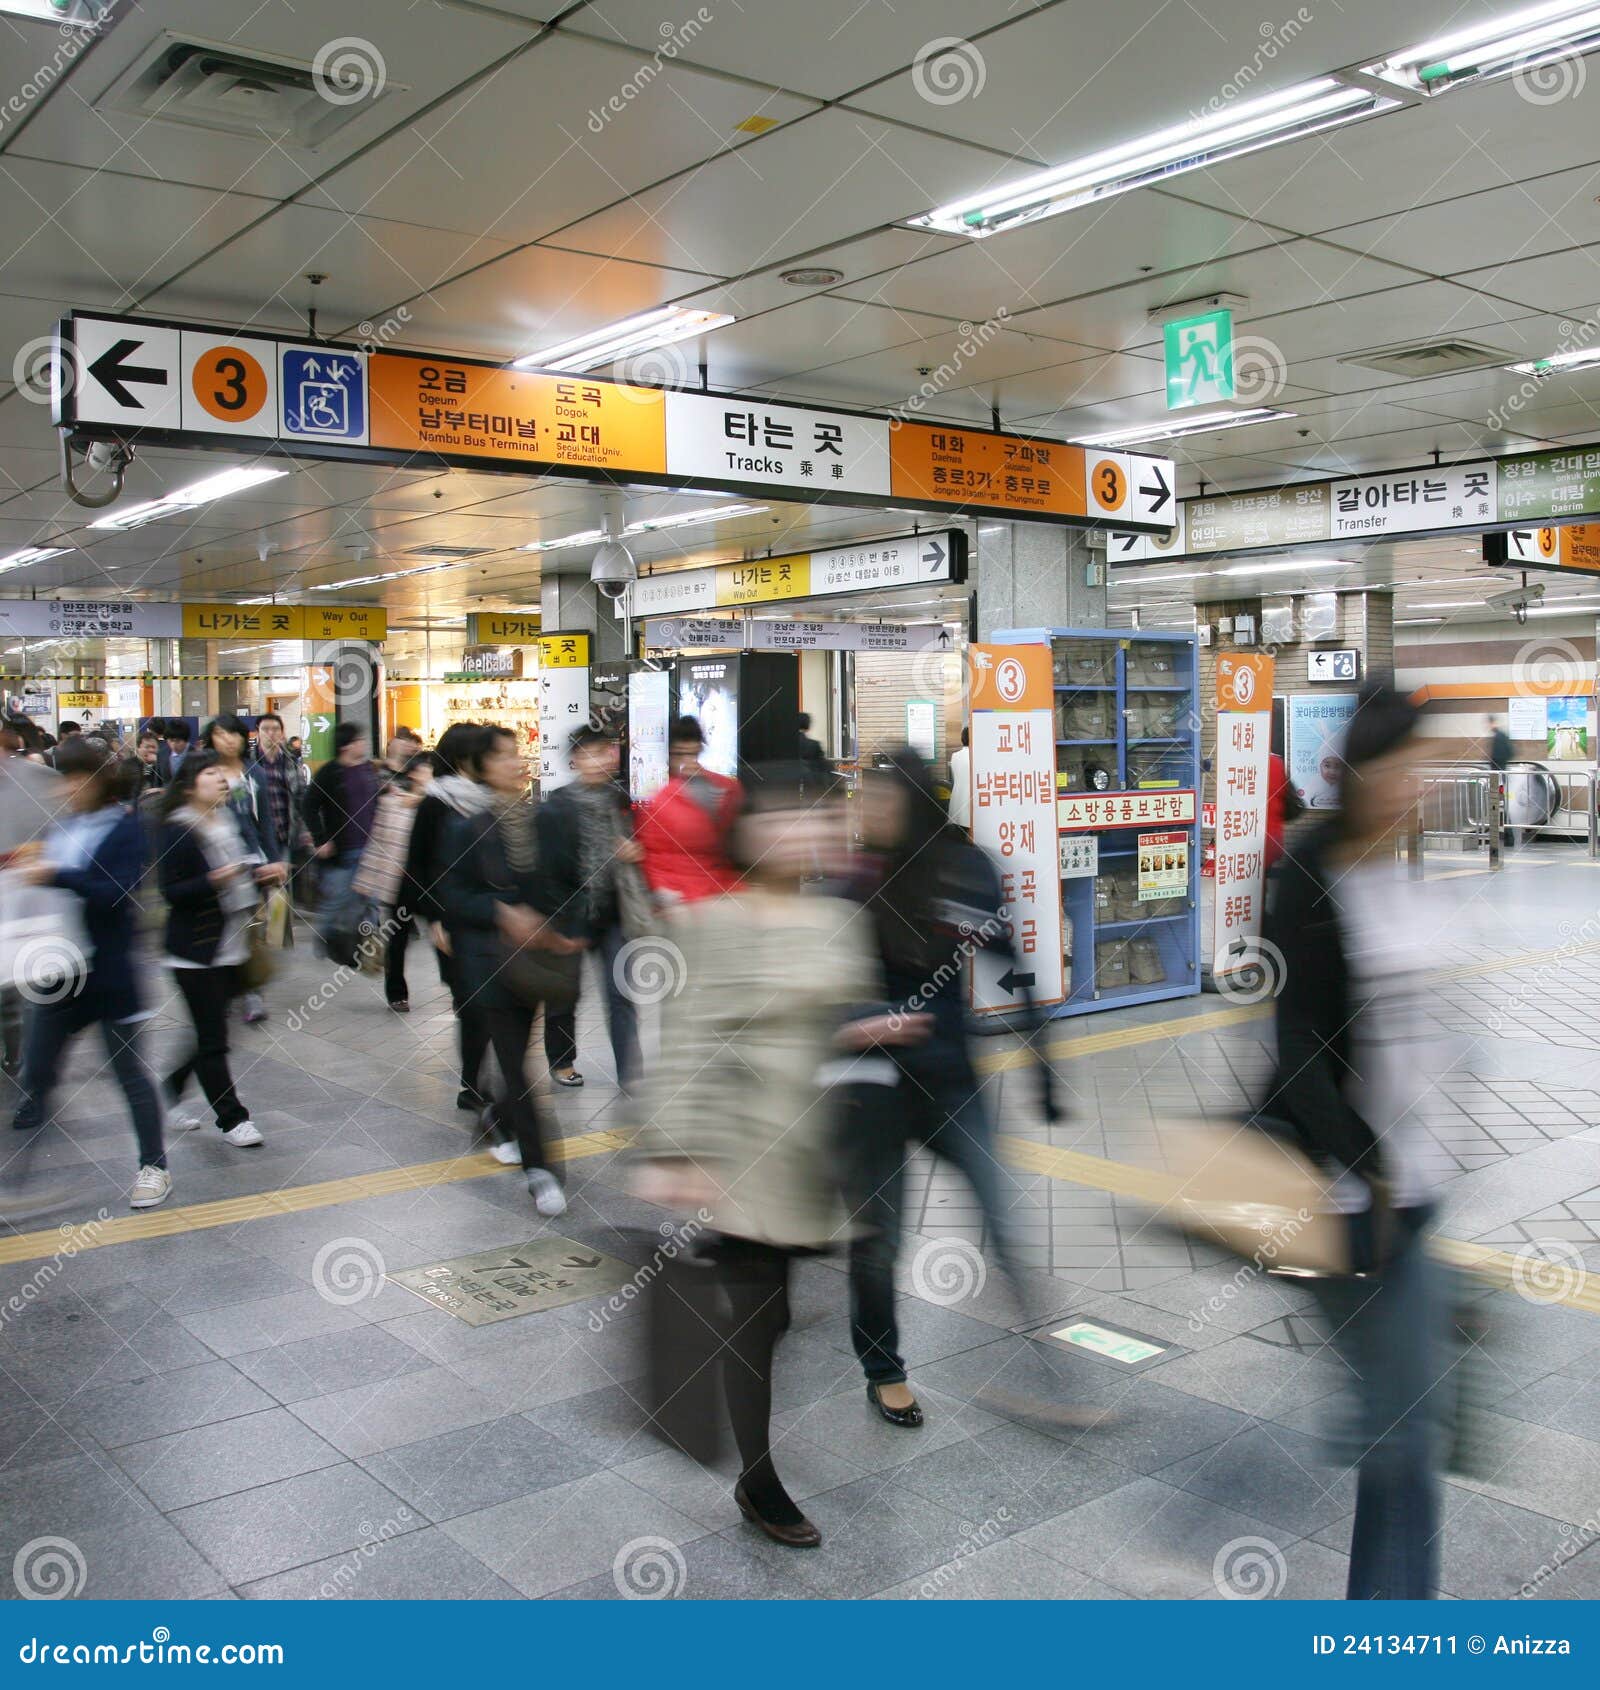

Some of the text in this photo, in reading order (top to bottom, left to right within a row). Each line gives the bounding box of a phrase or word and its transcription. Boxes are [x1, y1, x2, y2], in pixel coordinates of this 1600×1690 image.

[214, 358, 247, 410] 3
[418, 366, 601, 407] 오금 도곡
[418, 392, 588, 419] Ogeum Dogok
[418, 408, 600, 445] 남부터미널 교대
[724, 412, 843, 455] 타는 곳
[418, 431, 539, 452] Nambu Bus Terminal
[556, 442, 579, 452] Seoul
[931, 433, 1050, 464] 대화 구파발
[556, 451, 608, 463] of Education
[726, 452, 783, 474] Tracks
[1505, 461, 1537, 479] 장암
[932, 466, 1050, 495] 종로3가 충무로
[1101, 467, 1118, 504] 3
[1336, 471, 1489, 513] 갈아타는 곳
[1231, 494, 1281, 513] 김포공항
[1295, 488, 1323, 504] 당산
[1505, 484, 1585, 507] 이수 대림
[1337, 515, 1387, 531] Transfer
[1504, 503, 1584, 518] Isu Daerim
[732, 563, 792, 587] 나가는 곳
[734, 588, 758, 600] Way Out
[199, 614, 261, 631] 나가는
[272, 615, 289, 631] 곳
[322, 611, 368, 623] Way Out
[561, 639, 576, 653] 곳
[1003, 664, 1018, 697] 3
[1238, 671, 1249, 700] 3
[567, 703, 579, 713] 선
[997, 721, 1031, 756] 교대
[1232, 721, 1255, 752] 대화
[976, 770, 1052, 807] 남부터미널
[1227, 765, 1257, 796] 구파발
[1067, 796, 1183, 823] 소방용품보관함
[998, 820, 1036, 857] 양재
[1223, 808, 1259, 841] 종로3가
[1218, 850, 1262, 885] 을지로3가
[1001, 870, 1037, 904] 도곡
[1225, 895, 1252, 928] 충무로
[493, 1274, 538, 1298] Line
